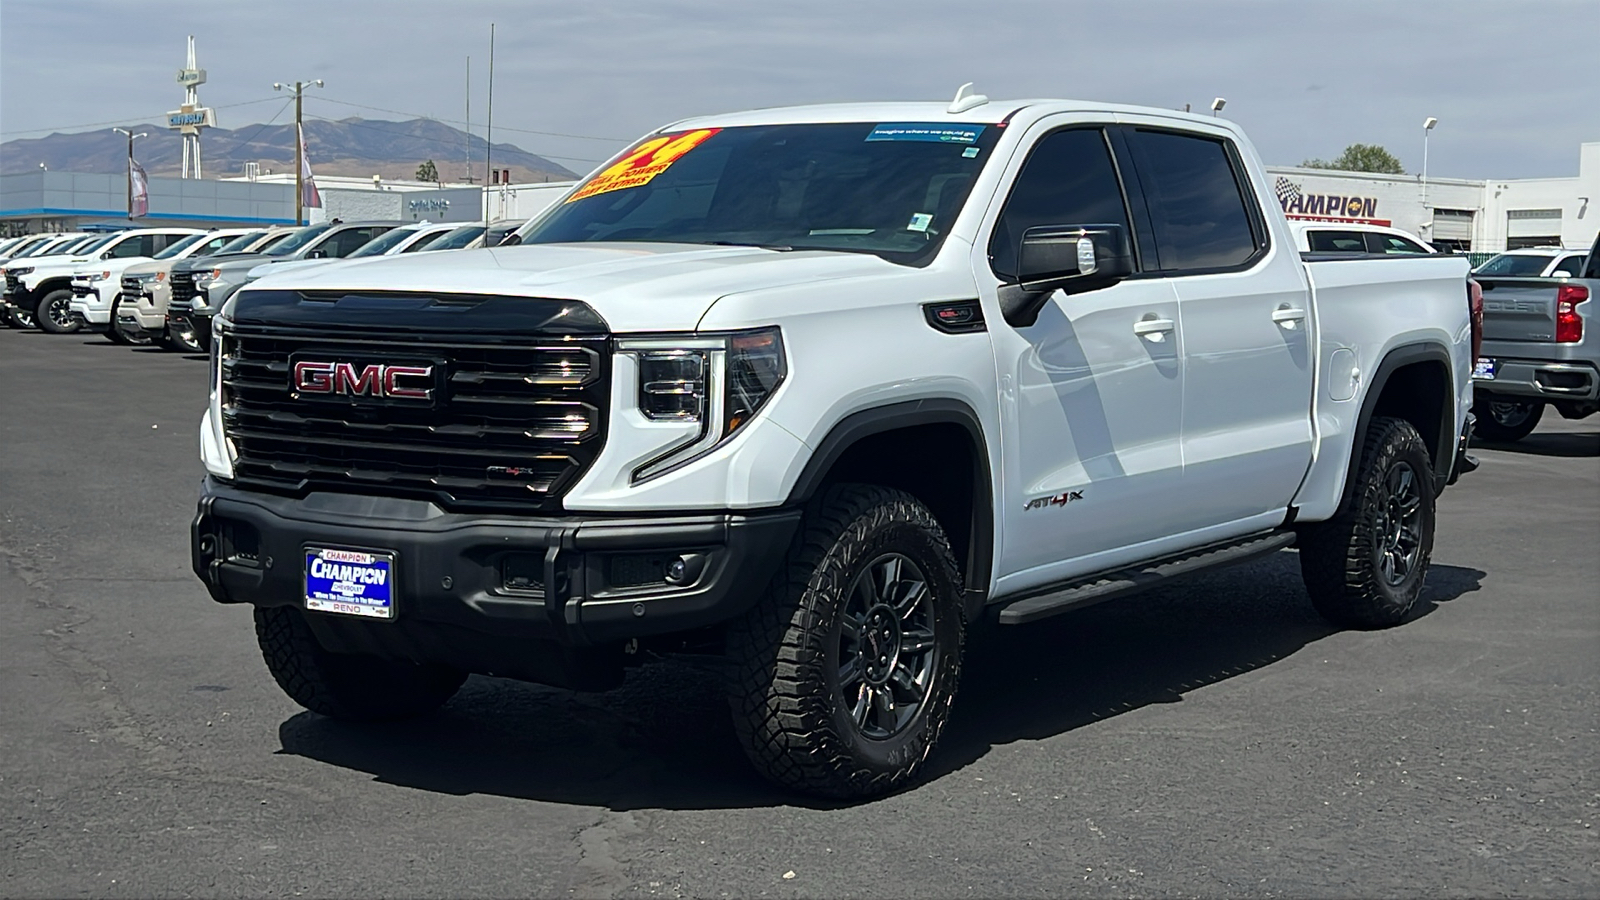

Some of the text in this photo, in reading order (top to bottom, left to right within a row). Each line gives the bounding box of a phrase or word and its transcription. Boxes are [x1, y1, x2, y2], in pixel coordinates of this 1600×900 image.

[617, 163, 668, 180] POWER
[1279, 193, 1377, 217] AMPION
[295, 355, 434, 400] GMC
[1023, 489, 1084, 511] AT4X
[326, 551, 367, 563] CHAMPION
[311, 558, 386, 585] CHAMPION
[333, 603, 361, 613] RENO
